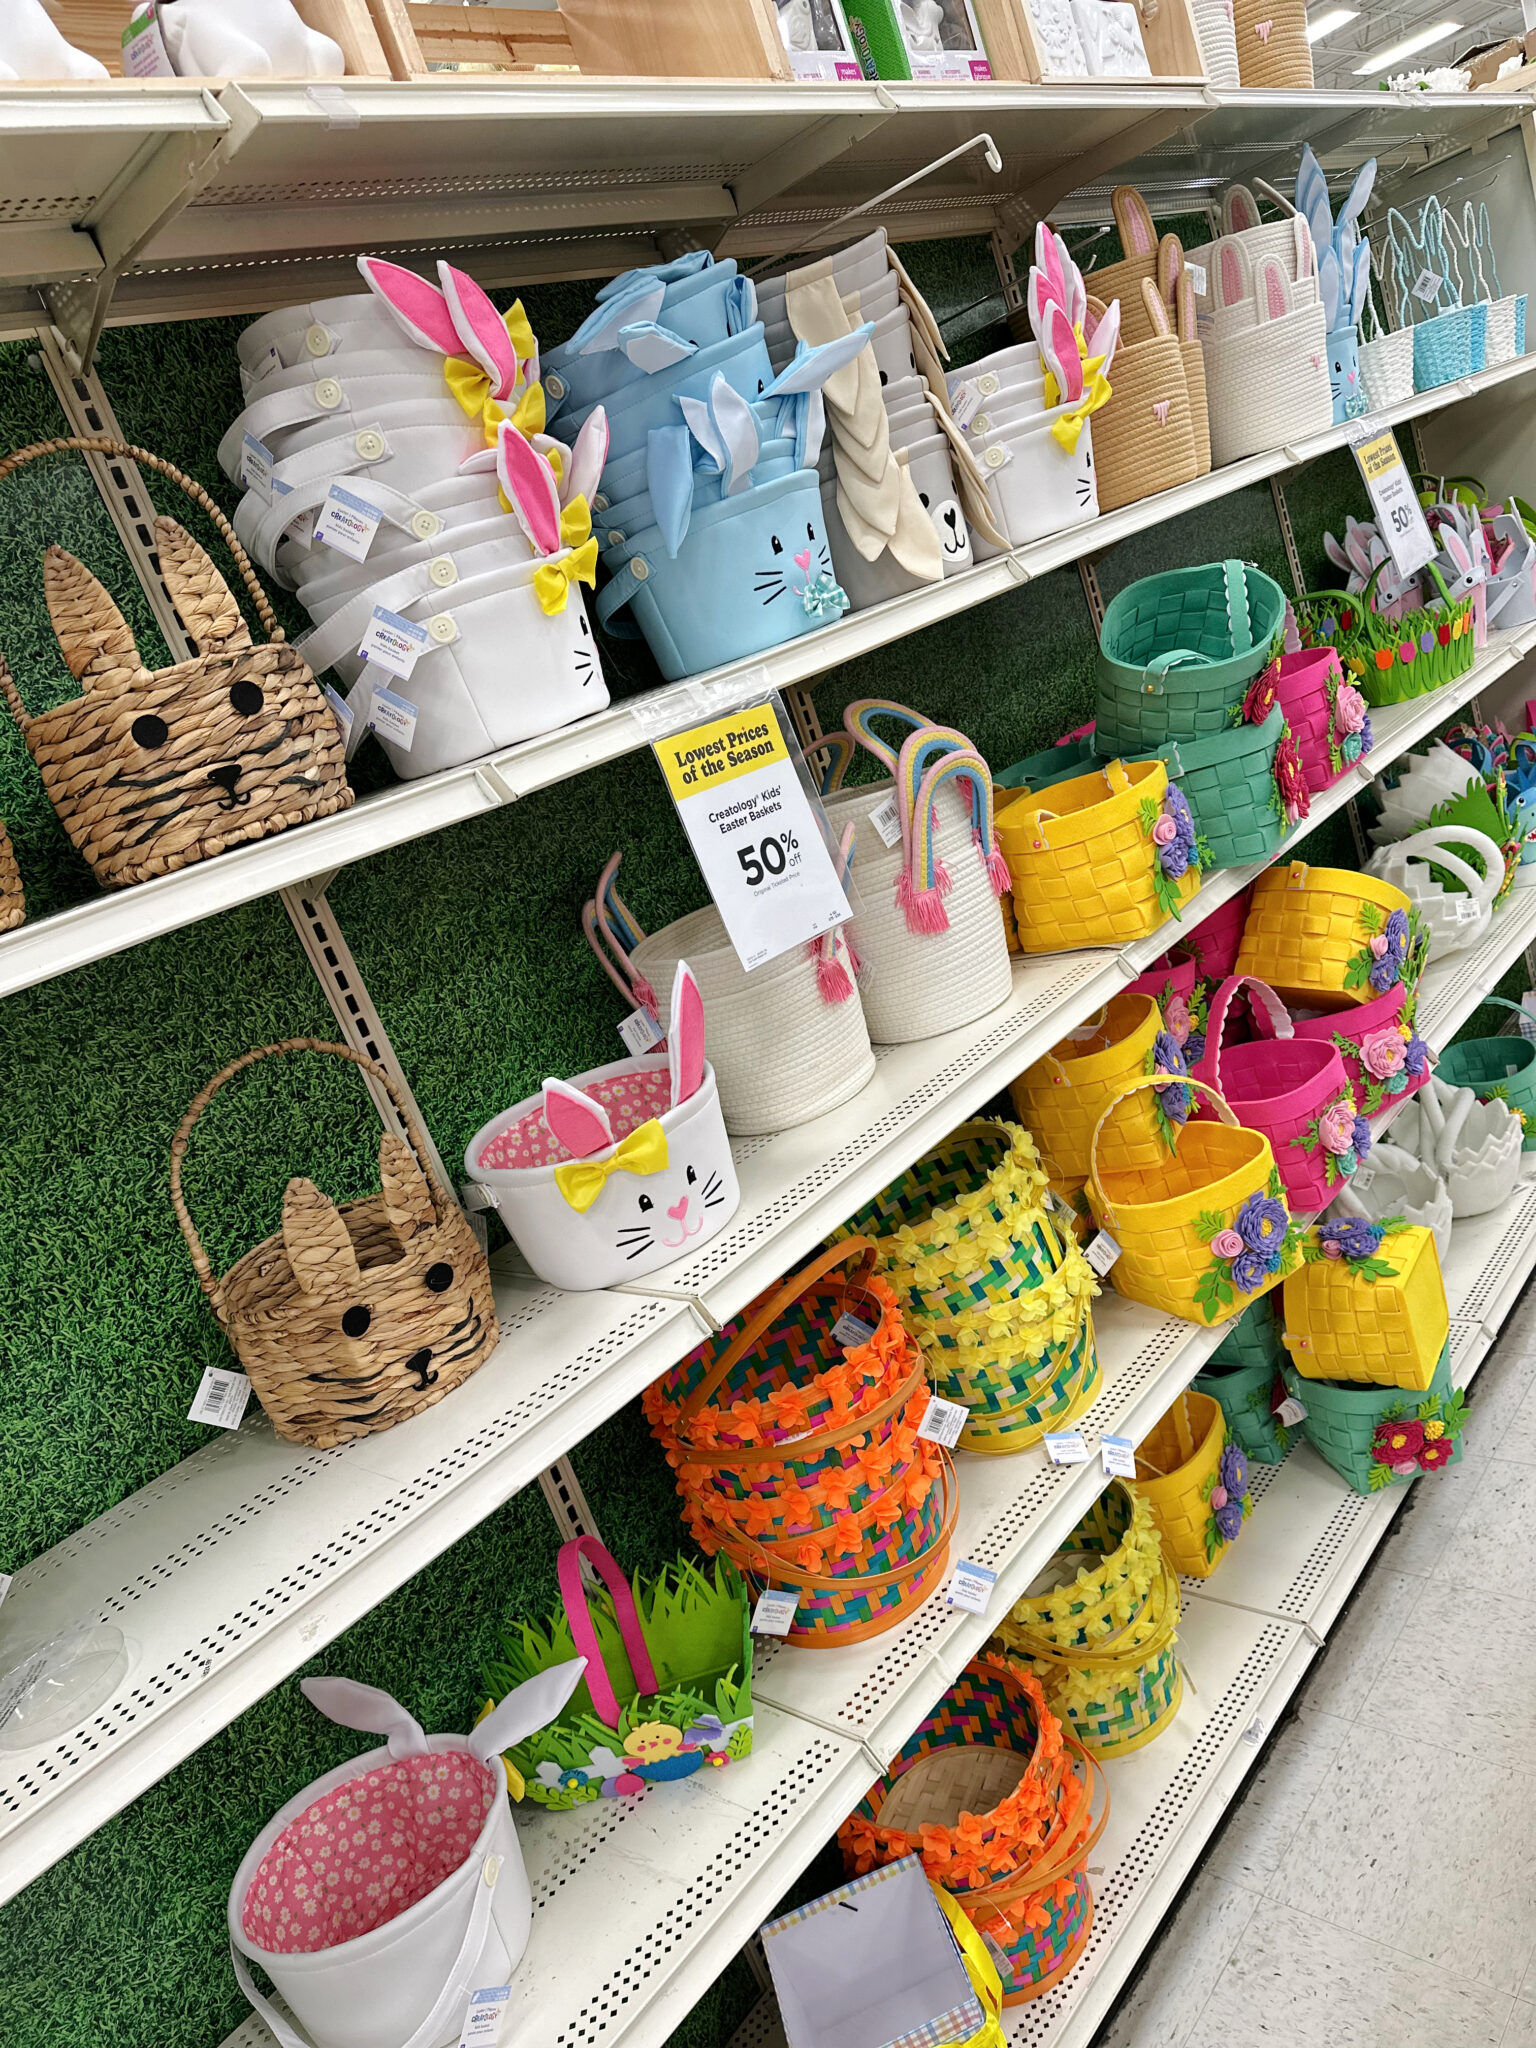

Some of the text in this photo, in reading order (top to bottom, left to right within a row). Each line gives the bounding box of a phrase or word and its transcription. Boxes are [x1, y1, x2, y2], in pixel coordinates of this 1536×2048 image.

[855, 23, 879, 80] REATOLOGY
[331, 511, 365, 533] CREATOLOGY
[1390, 503, 1412, 533] 50%
[375, 631, 409, 652] CREATOLOGY
[674, 724, 769, 768] Lowest Prices
[683, 740, 775, 784] of the Season
[761, 785, 781, 801] Kids'
[719, 801, 782, 834] Easter Baskets
[737, 829, 802, 886] 50% off
